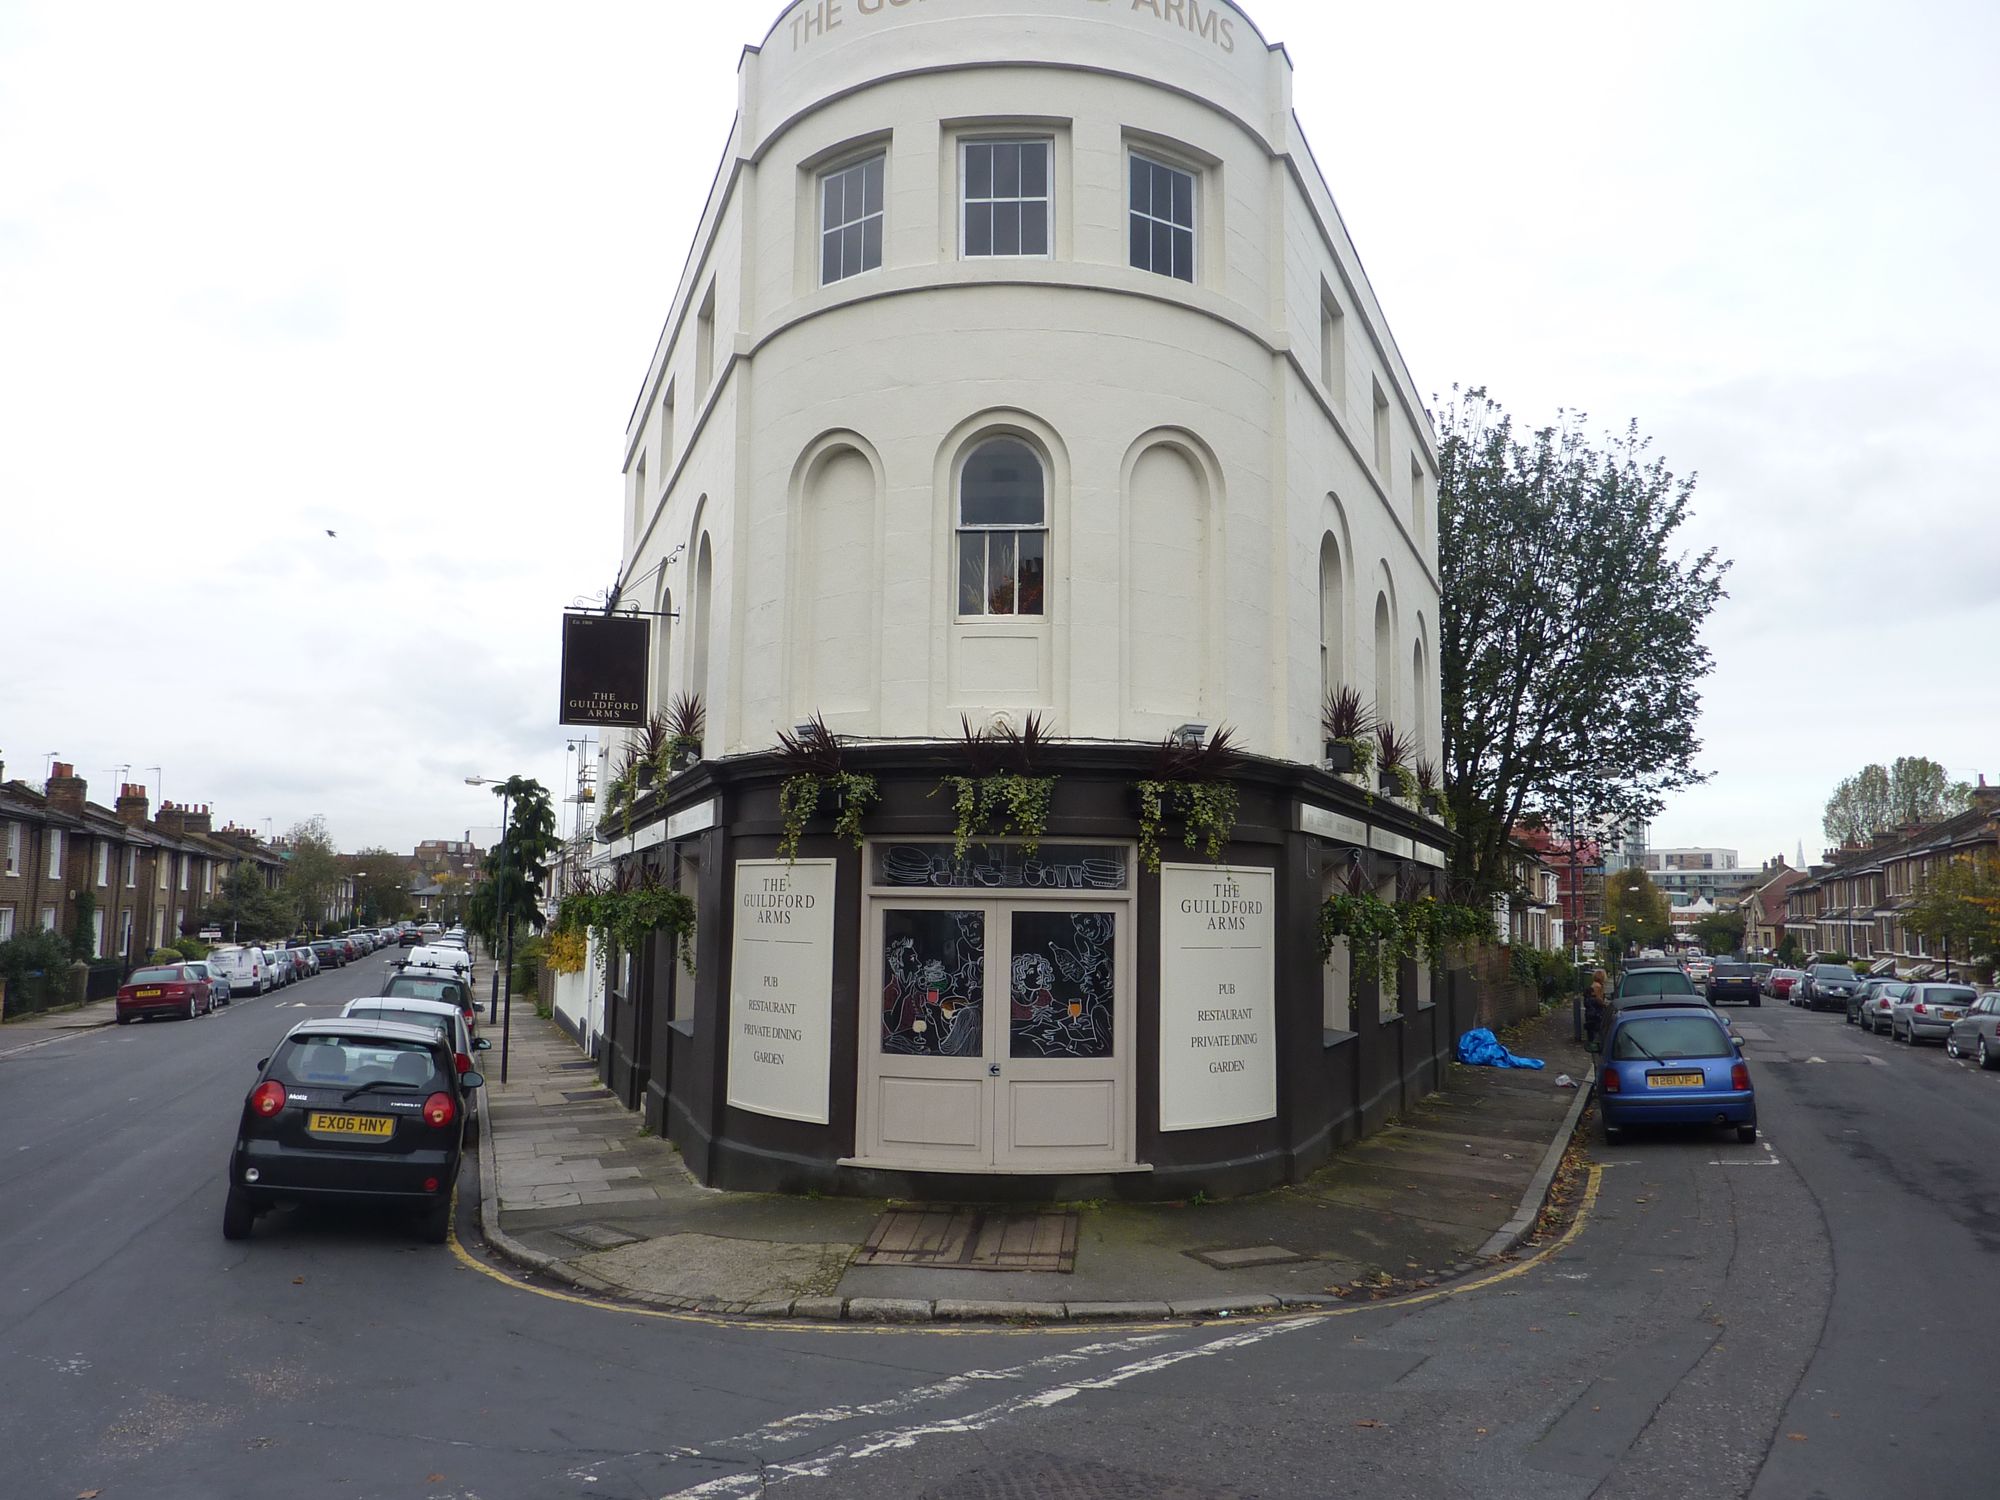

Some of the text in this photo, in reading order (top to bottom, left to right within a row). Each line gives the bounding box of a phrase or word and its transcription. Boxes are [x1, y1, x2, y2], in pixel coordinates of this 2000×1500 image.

[789, 0, 842, 52] THE
[593, 692, 616, 700] THE
[569, 700, 639, 711] GUILDFORD
[587, 709, 621, 718] ARMS
[763, 878, 787, 892] THE
[1213, 883, 1240, 898] THE
[743, 893, 815, 909] GUILDFORD
[1181, 899, 1263, 915] GUILDFORD
[757, 910, 791, 924] ARMS
[1207, 916, 1246, 931] ARMS
[763, 976, 778, 988] PUB
[1218, 983, 1236, 995] PUB
[748, 1000, 797, 1015] RESTAURANT
[1197, 1008, 1253, 1022] RESTAURANT
[743, 1023, 802, 1041] PRIVATE DINING
[1191, 1033, 1258, 1049] PRIVATE DINING
[753, 1051, 784, 1065] GARDEN
[1209, 1060, 1245, 1074] GARDEN
[1652, 1075, 1699, 1086] N261 VFJ
[317, 1115, 387, 1133] EX06 HNY
